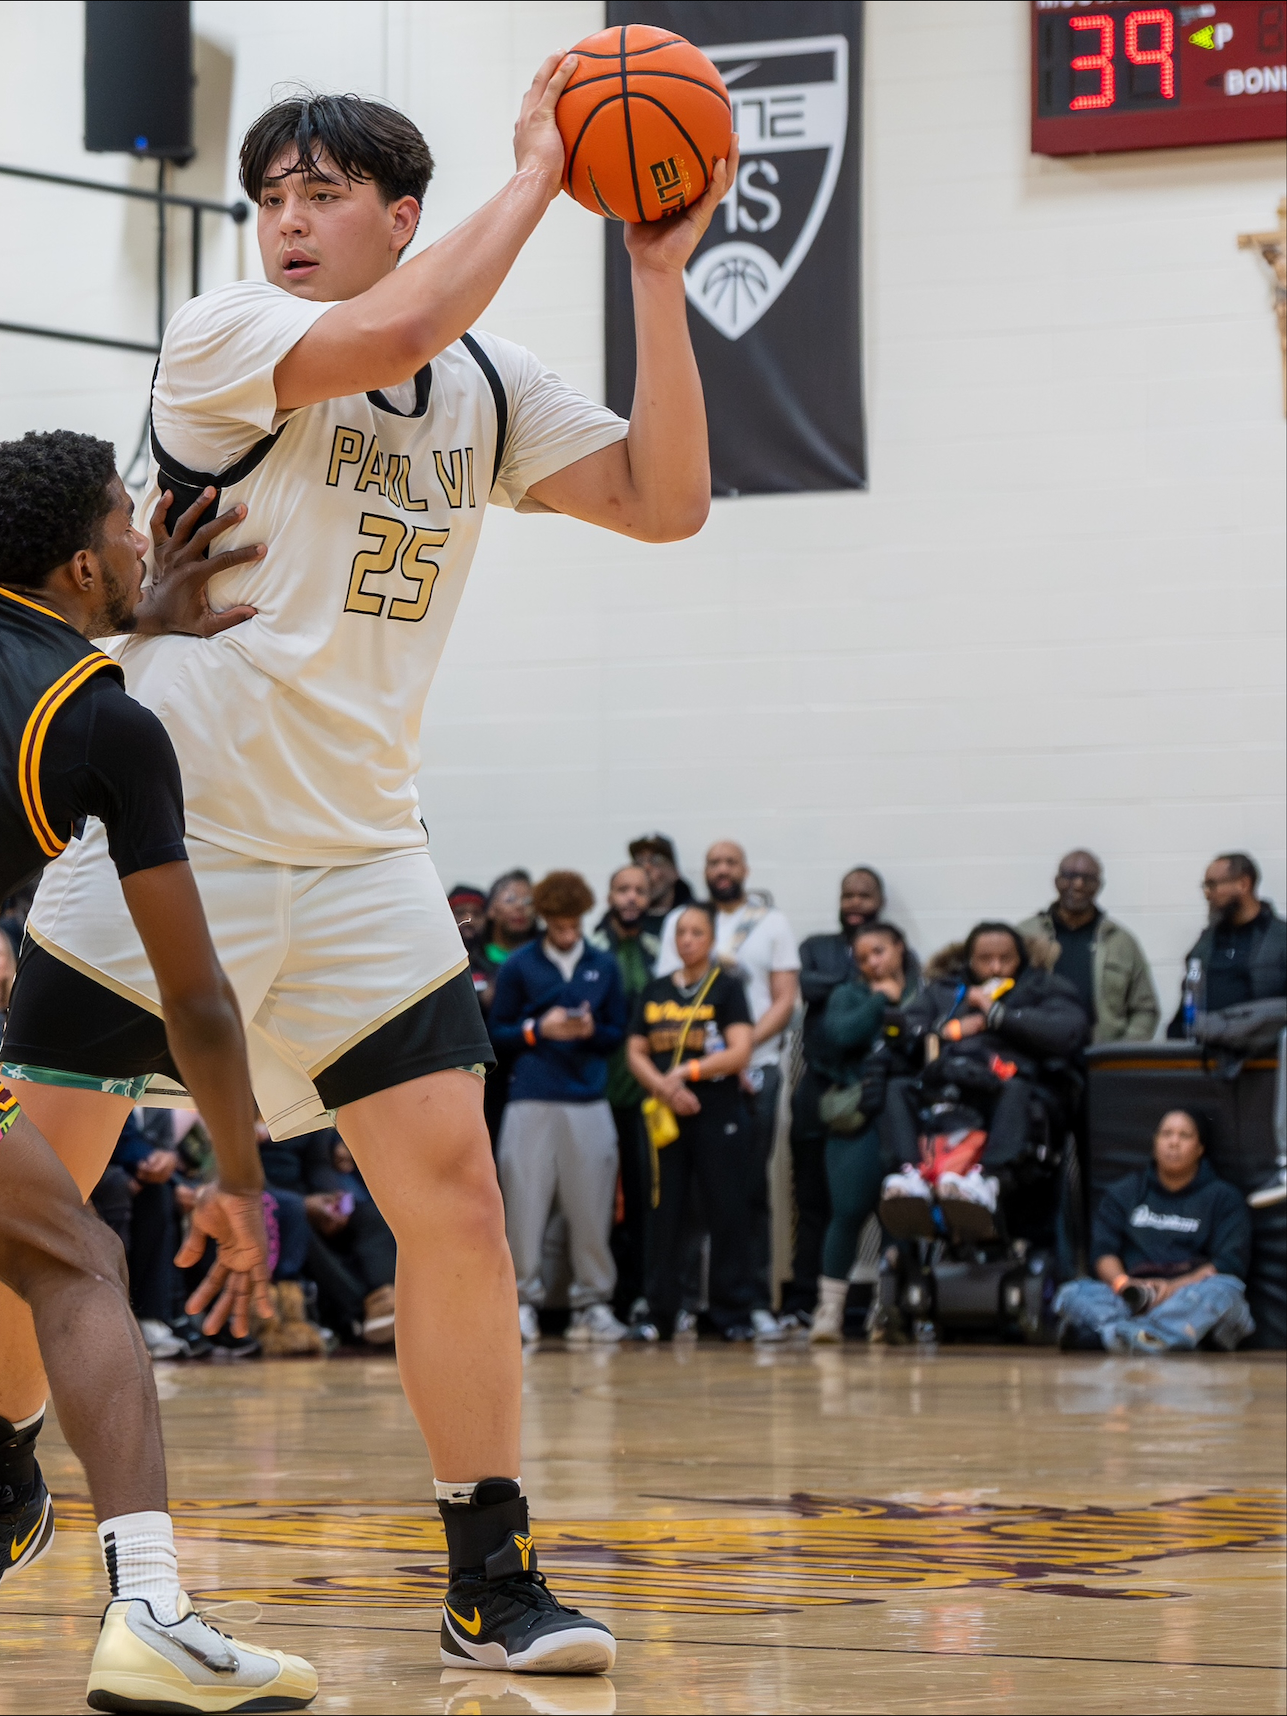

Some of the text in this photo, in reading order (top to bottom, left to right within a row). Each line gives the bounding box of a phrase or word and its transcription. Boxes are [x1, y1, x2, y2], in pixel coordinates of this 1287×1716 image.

[1069, 8, 1174, 111] 39
[1214, 22, 1234, 51] P
[432, 447, 476, 508] VI
[343, 511, 450, 622] 25
